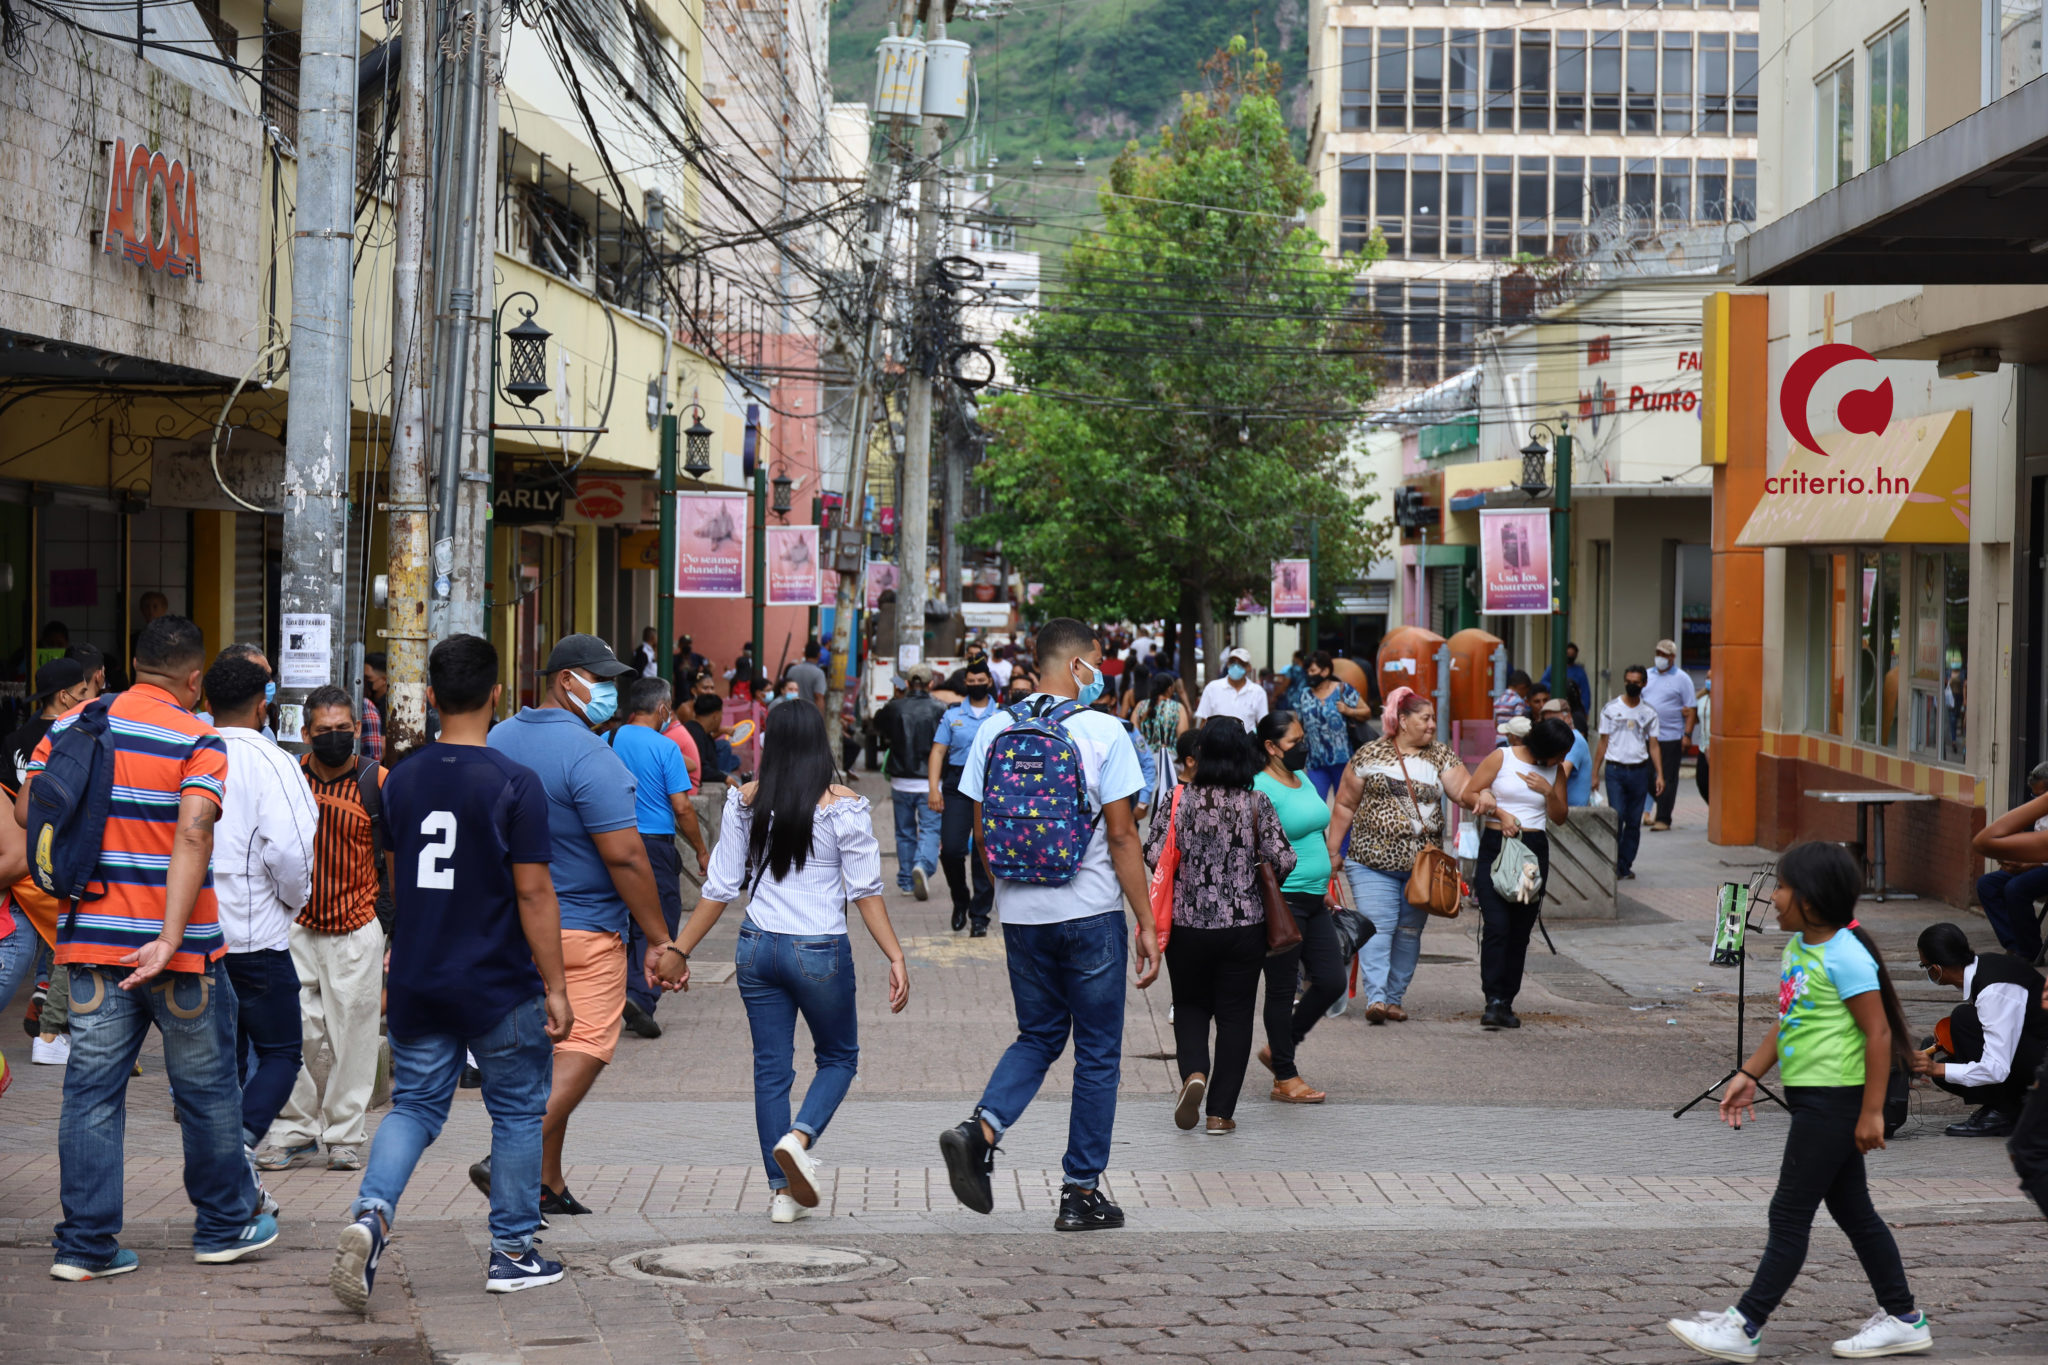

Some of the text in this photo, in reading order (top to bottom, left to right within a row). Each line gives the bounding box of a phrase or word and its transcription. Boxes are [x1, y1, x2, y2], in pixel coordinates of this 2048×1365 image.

[102, 136, 203, 284] ACOSA
[1629, 385, 1696, 412] Punto
[700, 556, 739, 564] seamos
[1489, 581, 1545, 591] basureros
[1498, 572, 1538, 582] Usa los
[416, 810, 458, 890] 2
